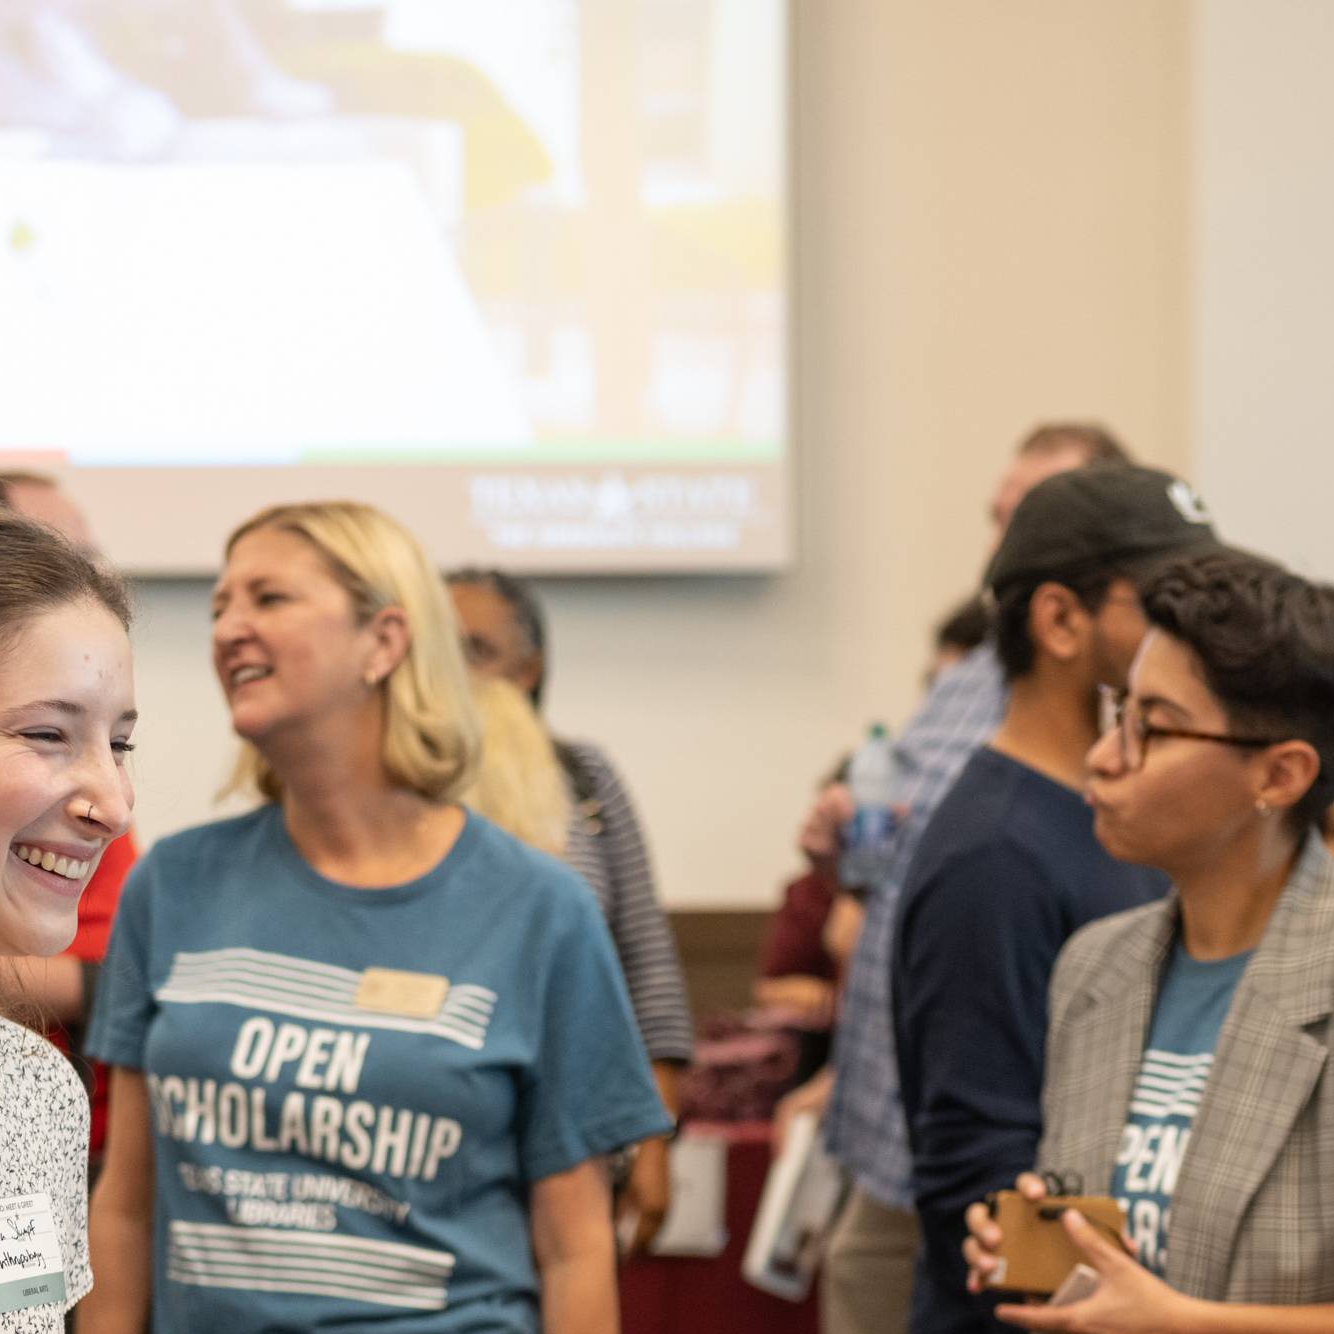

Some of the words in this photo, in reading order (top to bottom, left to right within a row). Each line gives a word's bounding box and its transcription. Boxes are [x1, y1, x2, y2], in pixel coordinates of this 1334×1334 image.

[230, 1017, 369, 1094] OPEN
[223, 1169, 289, 1200] STATE
[1116, 1124, 1193, 1194] PEN
[228, 1198, 338, 1231] LIBRARIES
